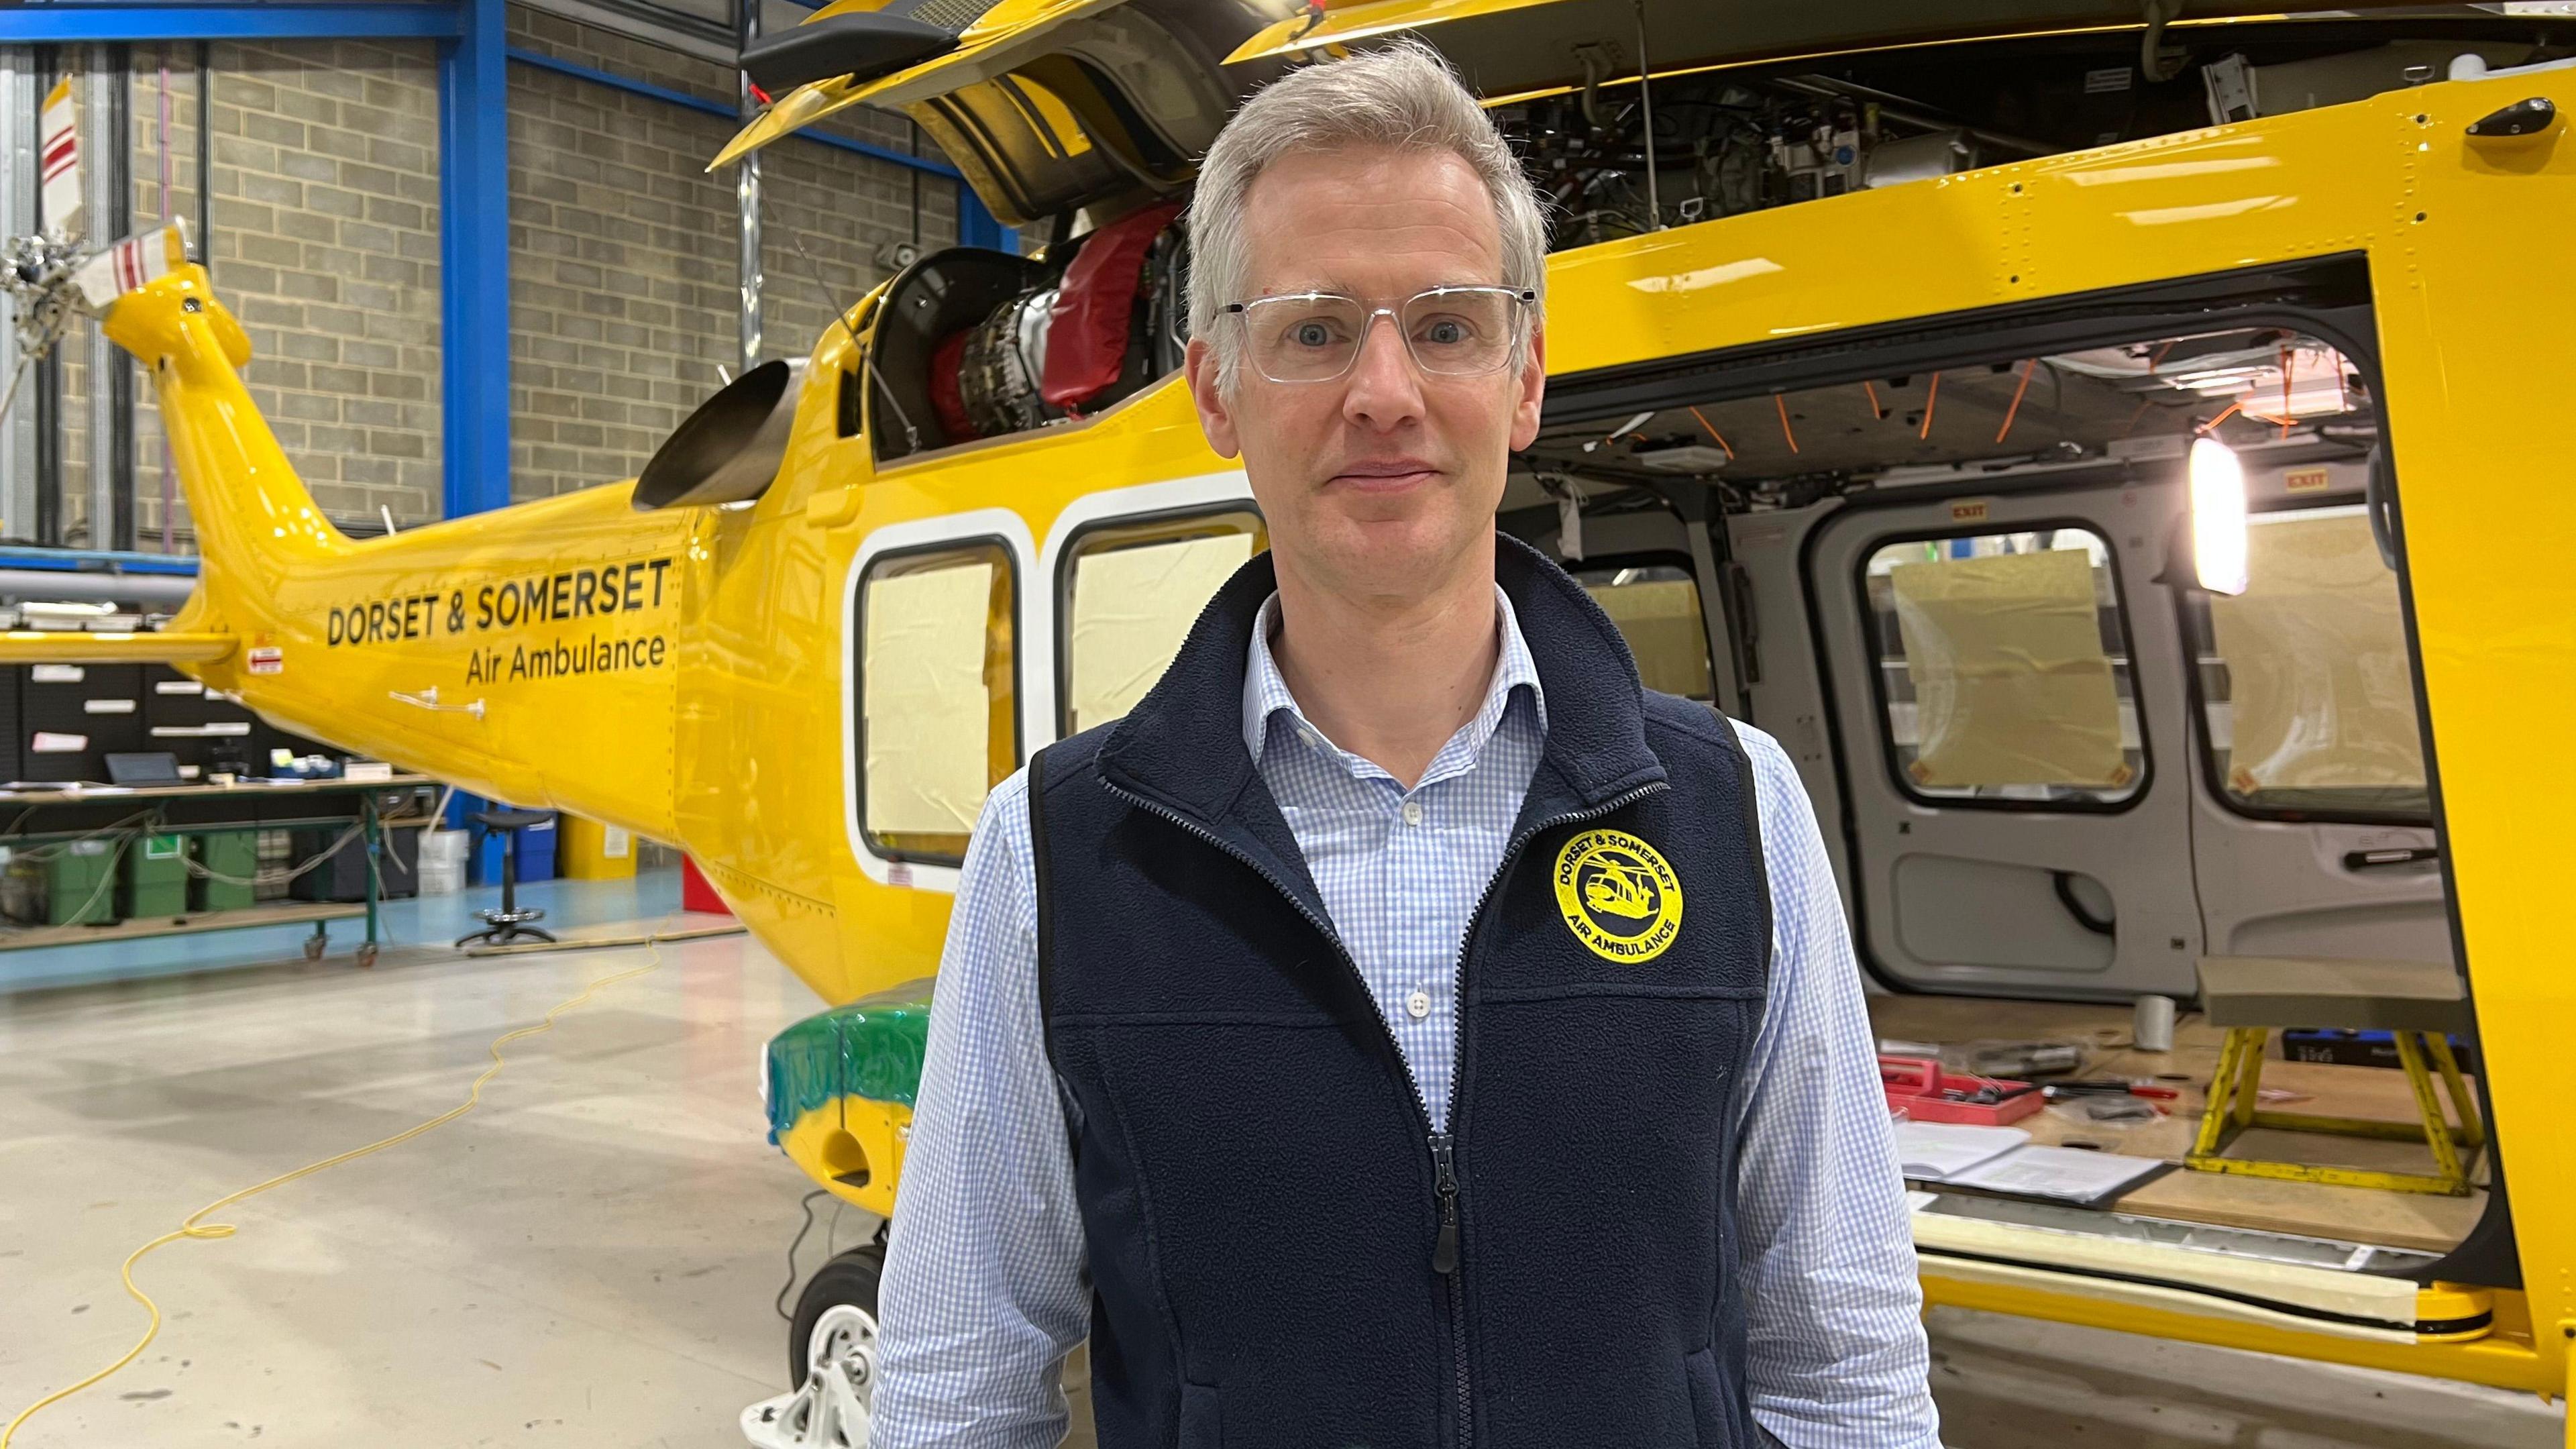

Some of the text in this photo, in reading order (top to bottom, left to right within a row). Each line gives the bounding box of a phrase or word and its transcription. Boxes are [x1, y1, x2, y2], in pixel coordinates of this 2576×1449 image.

[2288, 472, 2324, 488] EXIT
[1953, 504, 1984, 519] EXIT
[328, 559, 671, 646] DORSET & SOMERSET
[467, 633, 665, 685] Air Ambulance
[1560, 835, 1675, 892] DORSET & SOMERSET
[1568, 915, 1675, 956] AIR AMBULANCE
